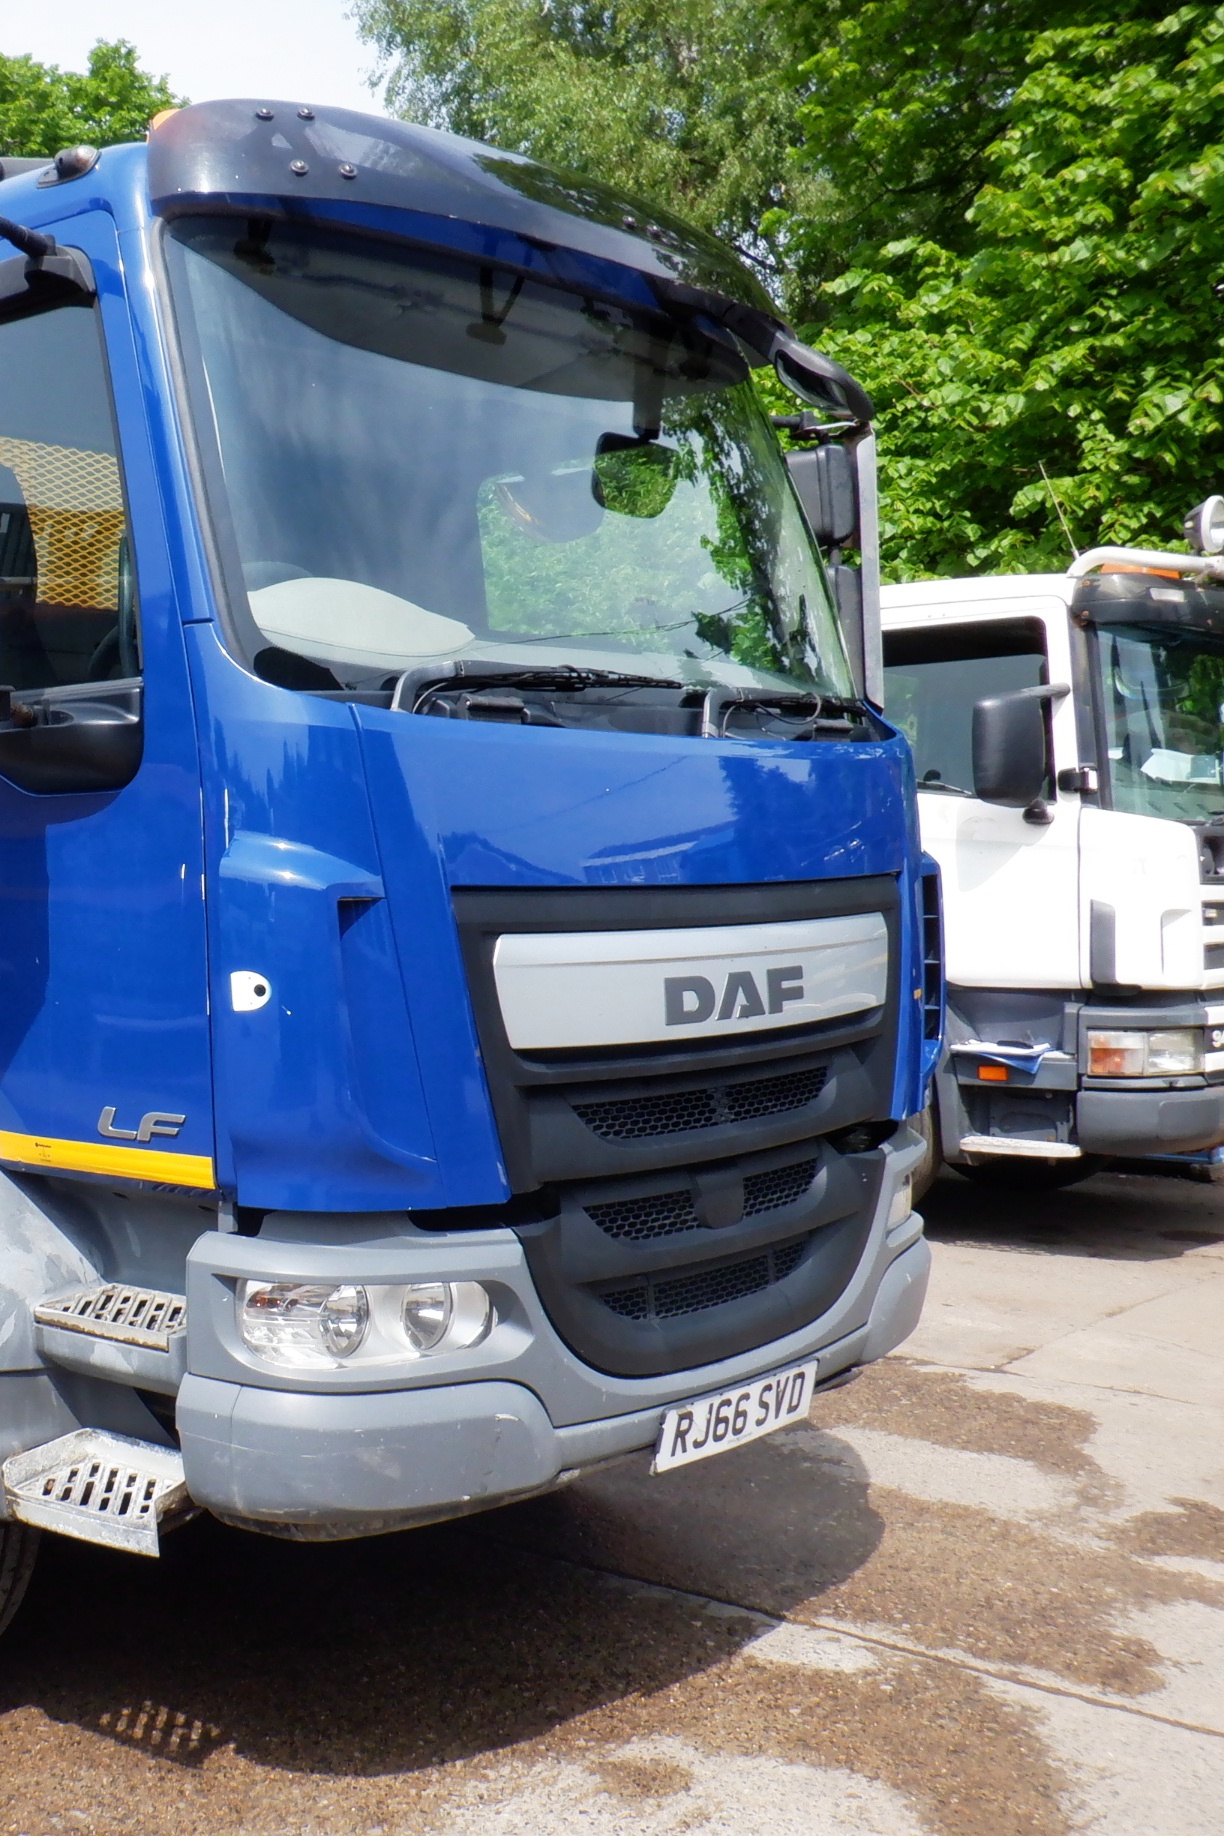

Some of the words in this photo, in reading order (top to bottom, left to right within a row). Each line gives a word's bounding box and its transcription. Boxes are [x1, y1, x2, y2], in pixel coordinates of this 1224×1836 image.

[664, 965, 804, 1026] DAF
[97, 1105, 186, 1142] LF
[670, 1392, 751, 1457] RJ66
[755, 1371, 806, 1427] SVD
